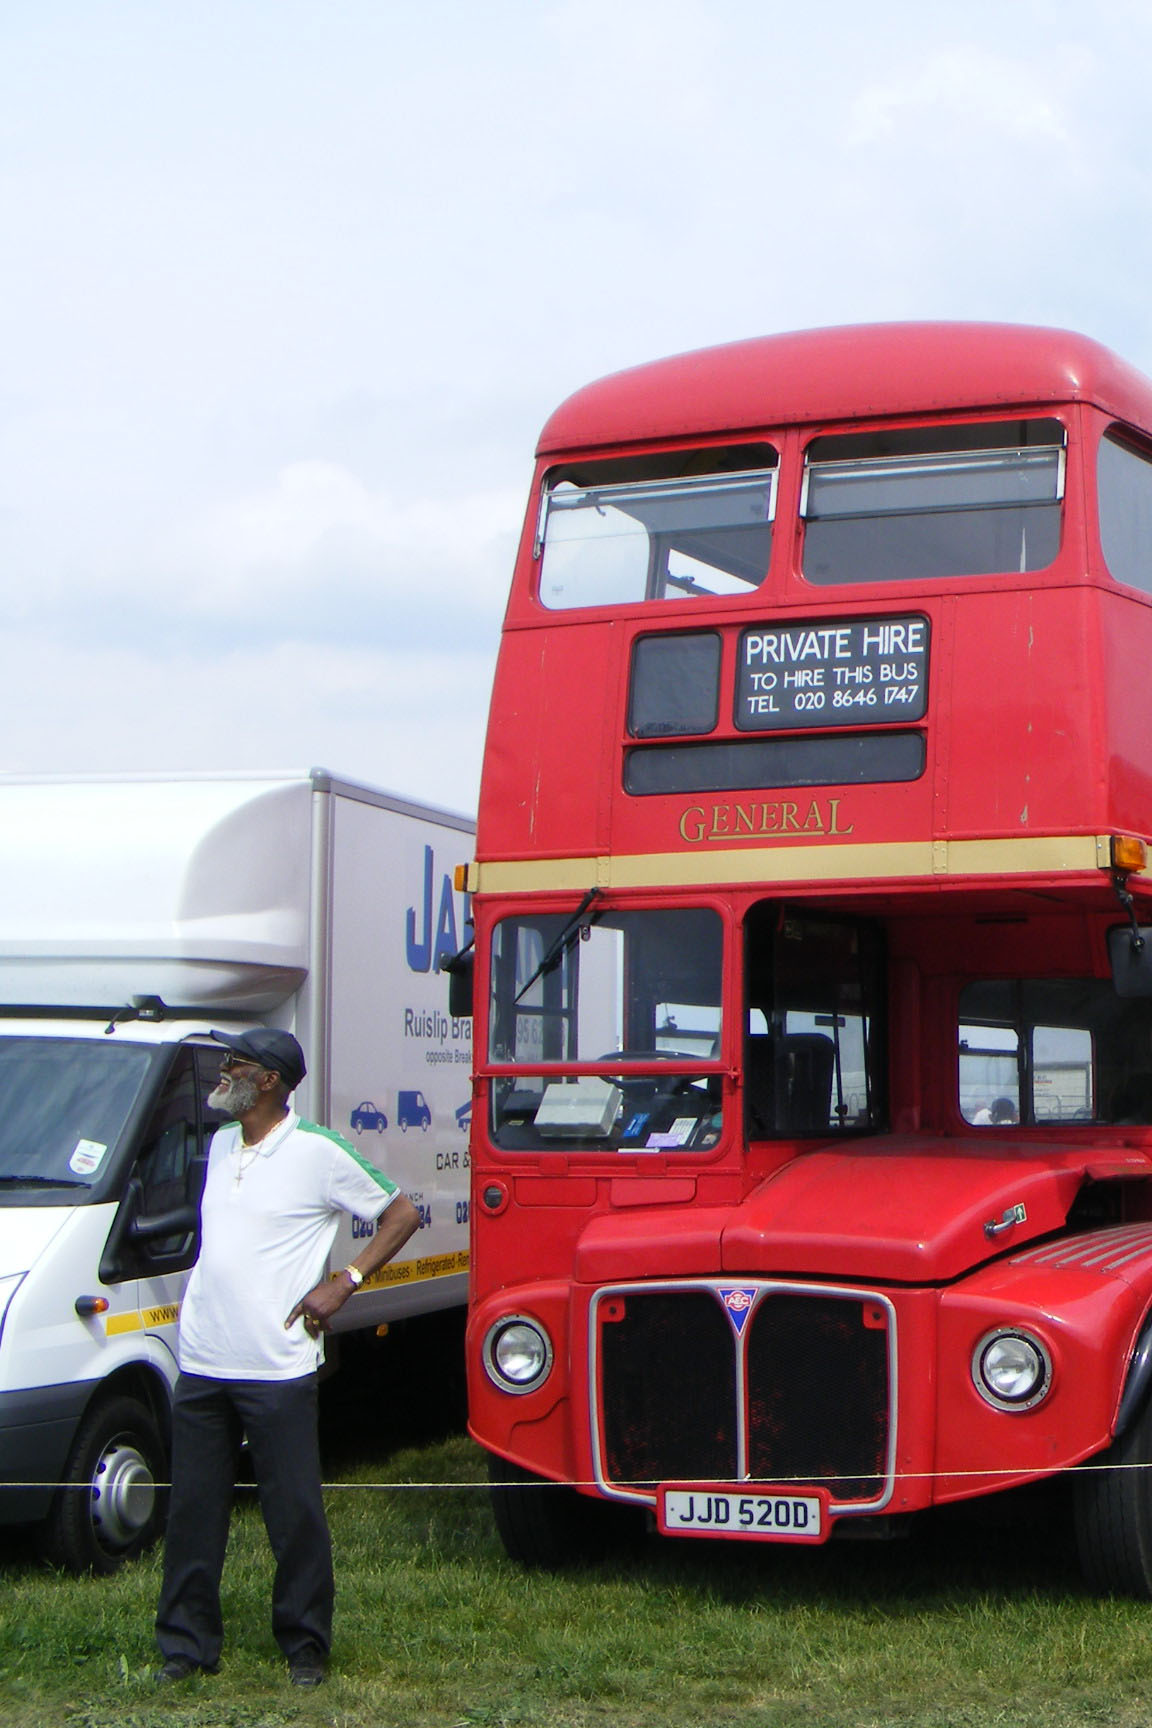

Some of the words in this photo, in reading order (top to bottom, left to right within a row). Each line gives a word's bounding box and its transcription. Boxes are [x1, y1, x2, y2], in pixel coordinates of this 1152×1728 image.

[746, 629, 852, 665] PRIVATE
[863, 623, 924, 657] HIRE
[750, 672, 778, 691] TO
[784, 669, 826, 689] HIRE
[832, 665, 873, 685] THIS
[880, 662, 918, 682] BUS
[747, 695, 780, 713] TEL
[794, 691, 826, 710] 020
[832, 688, 877, 708] 8646
[884, 684, 919, 705] 1747
[680, 799, 854, 843] GENERAL
[406, 844, 475, 975] JA
[404, 1008, 448, 1045] Ruislip
[425, 1050, 453, 1066] opposite
[436, 1152, 460, 1170] CAR
[679, 1496, 730, 1524] JJD
[738, 1498, 808, 1528] 520D
